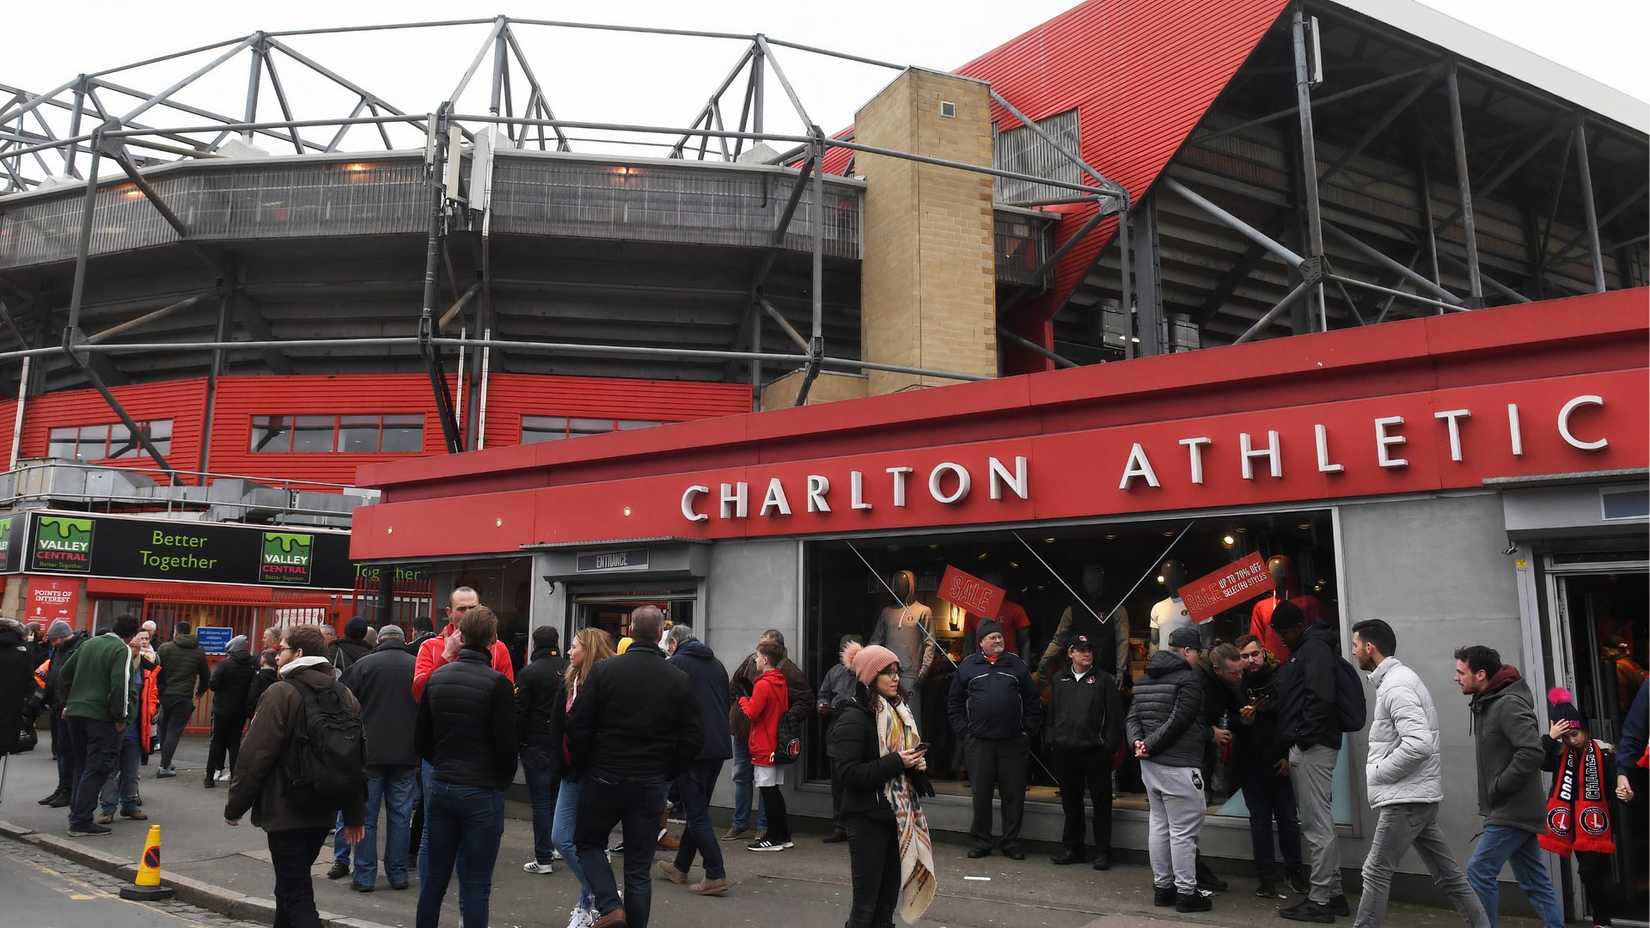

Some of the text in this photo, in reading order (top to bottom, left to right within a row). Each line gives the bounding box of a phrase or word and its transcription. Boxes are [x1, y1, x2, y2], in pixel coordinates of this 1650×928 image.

[680, 394, 1608, 522] CHARLTON ATHLETIC
[40, 539, 89, 552] VALLEY
[152, 530, 208, 549] Better
[36, 551, 88, 562] CENTRAL
[139, 550, 218, 572] Together
[264, 554, 309, 566] VALLEY
[596, 552, 627, 569] ENTRANCE
[263, 565, 307, 575] CENTRAL
[353, 563, 421, 582] Togher
[1218, 561, 1262, 589] UP TO 70% OFF
[34, 589, 62, 597] POINTS
[951, 575, 993, 613] SALE
[1222, 573, 1268, 598] SELECTED STYLES
